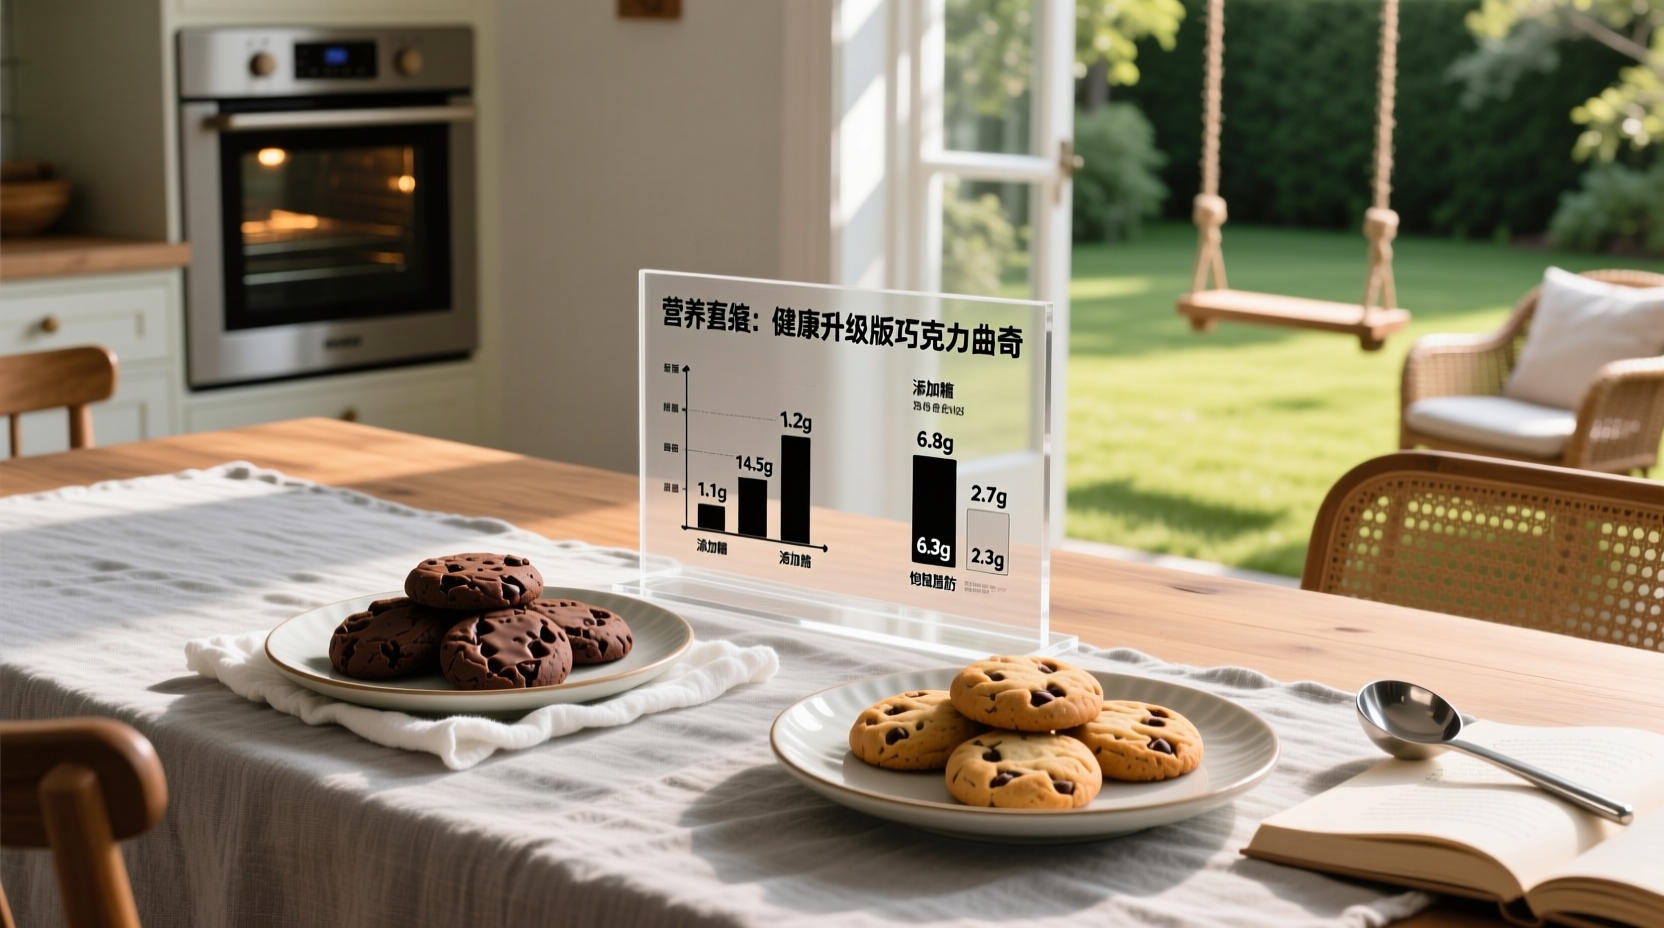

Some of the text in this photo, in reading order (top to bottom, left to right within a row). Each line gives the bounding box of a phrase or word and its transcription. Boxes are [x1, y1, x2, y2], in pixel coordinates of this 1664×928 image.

[780, 411, 812, 434] 1.2g
[916, 430, 954, 455] 6.8g
[735, 455, 773, 478] 14.5g
[698, 481, 727, 503] 1.1g
[970, 485, 1008, 509] 2.7g
[916, 537, 951, 562] 6.3g
[971, 548, 1005, 571] 2.3g
